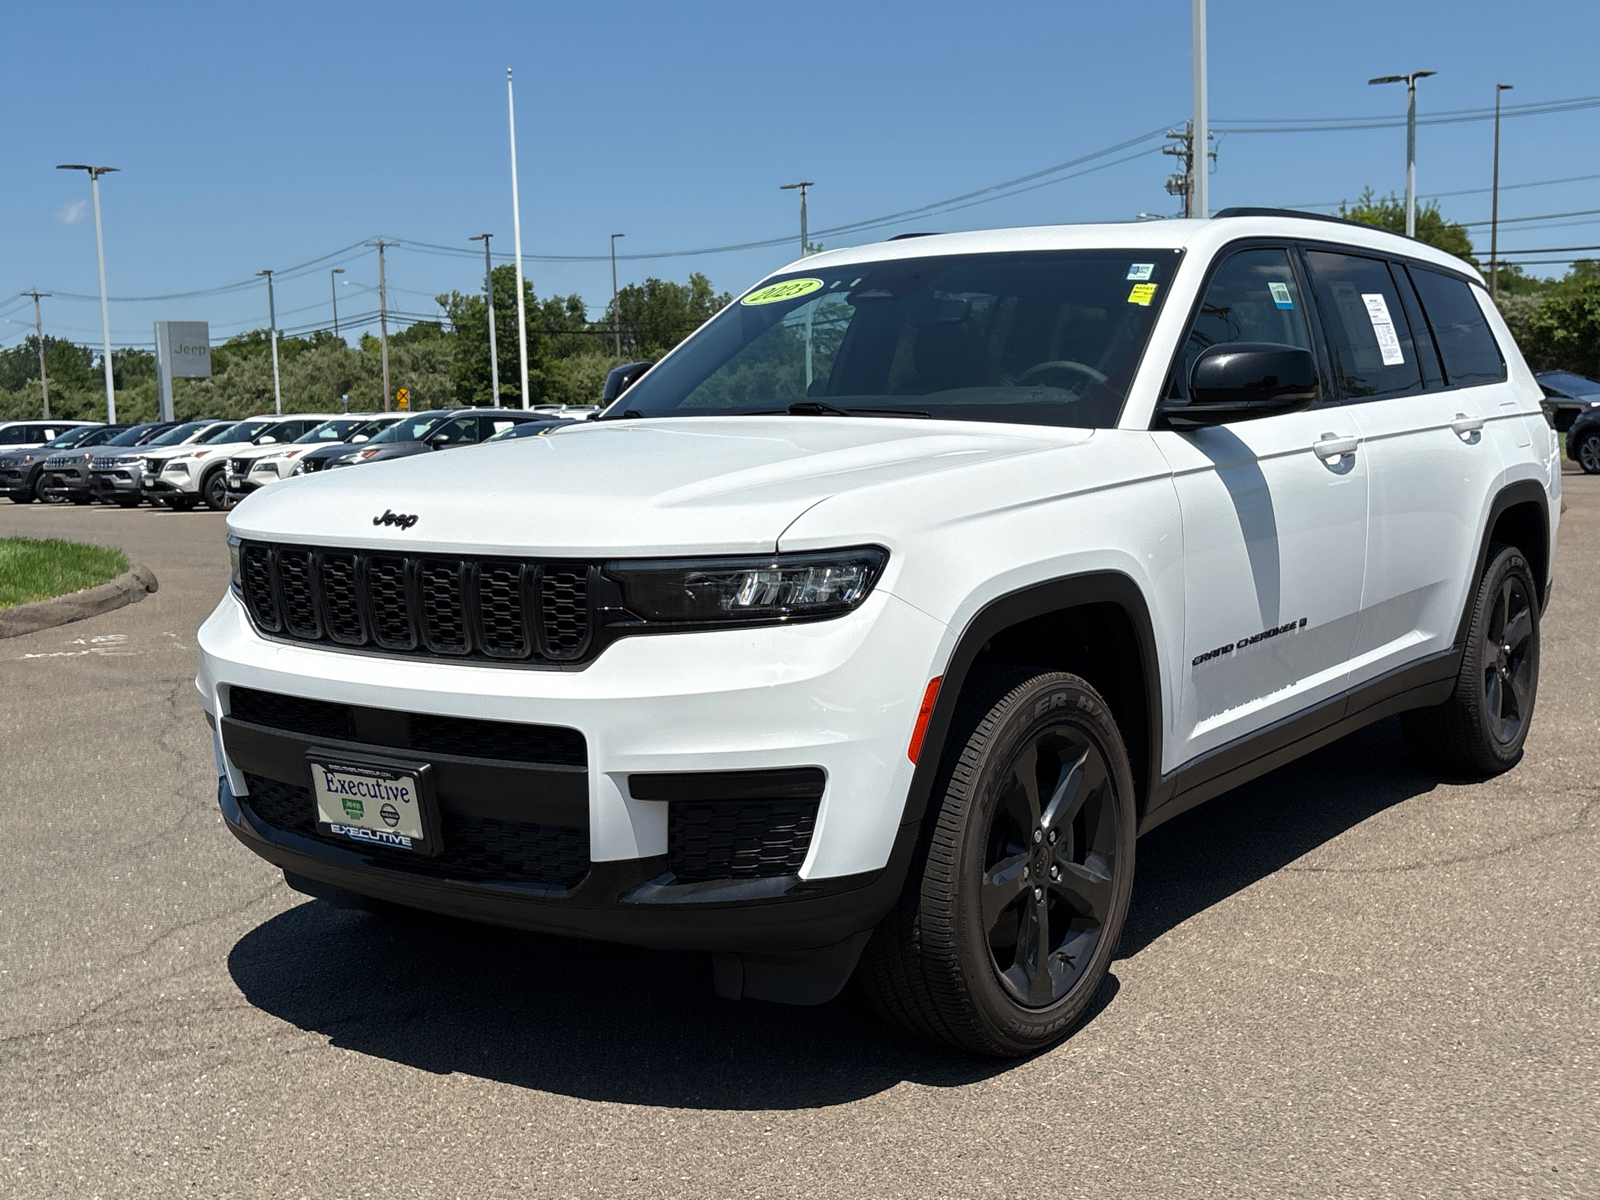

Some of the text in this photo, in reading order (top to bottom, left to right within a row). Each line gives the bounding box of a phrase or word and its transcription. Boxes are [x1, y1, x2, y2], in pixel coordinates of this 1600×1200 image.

[748, 281, 814, 302] 2023
[174, 343, 207, 358] Jeep
[372, 508, 419, 531] Jeep
[1192, 643, 1235, 666] GRAND
[1236, 620, 1298, 649] CHEROKEE
[322, 770, 411, 804] Executive
[345, 800, 361, 810] Jeep
[330, 824, 412, 847] EXECUTIVE
